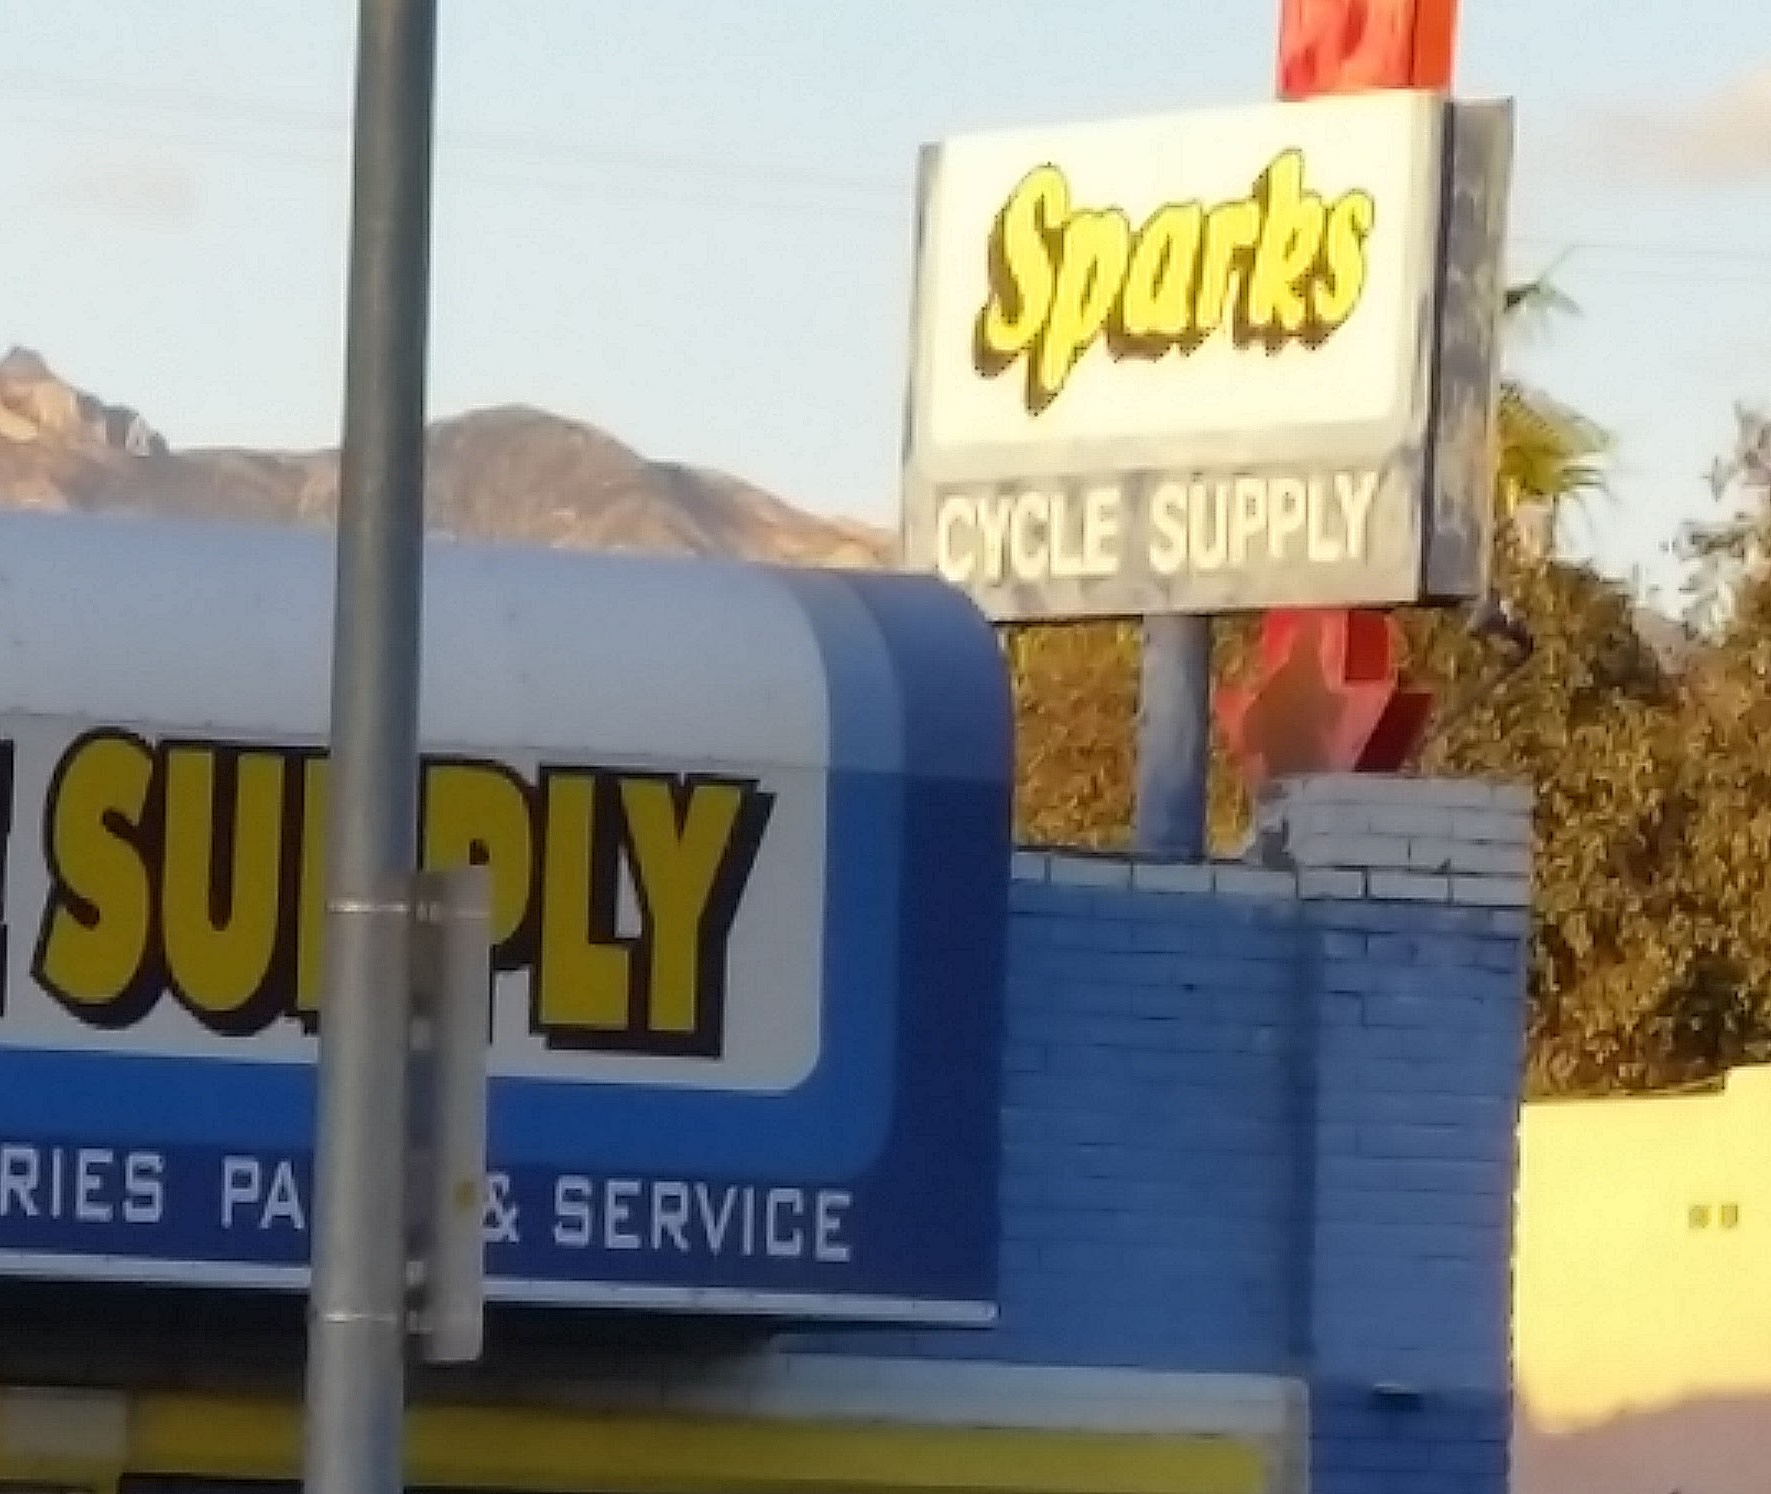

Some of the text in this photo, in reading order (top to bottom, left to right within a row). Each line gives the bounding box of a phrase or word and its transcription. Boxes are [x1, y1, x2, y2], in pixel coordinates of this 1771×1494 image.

[974, 148, 1375, 416] Sparks
[934, 471, 1381, 584] CYCLE SUPPLY
[31, 726, 775, 1058] SUPLY
[553, 1174, 853, 1264] SERVICE
